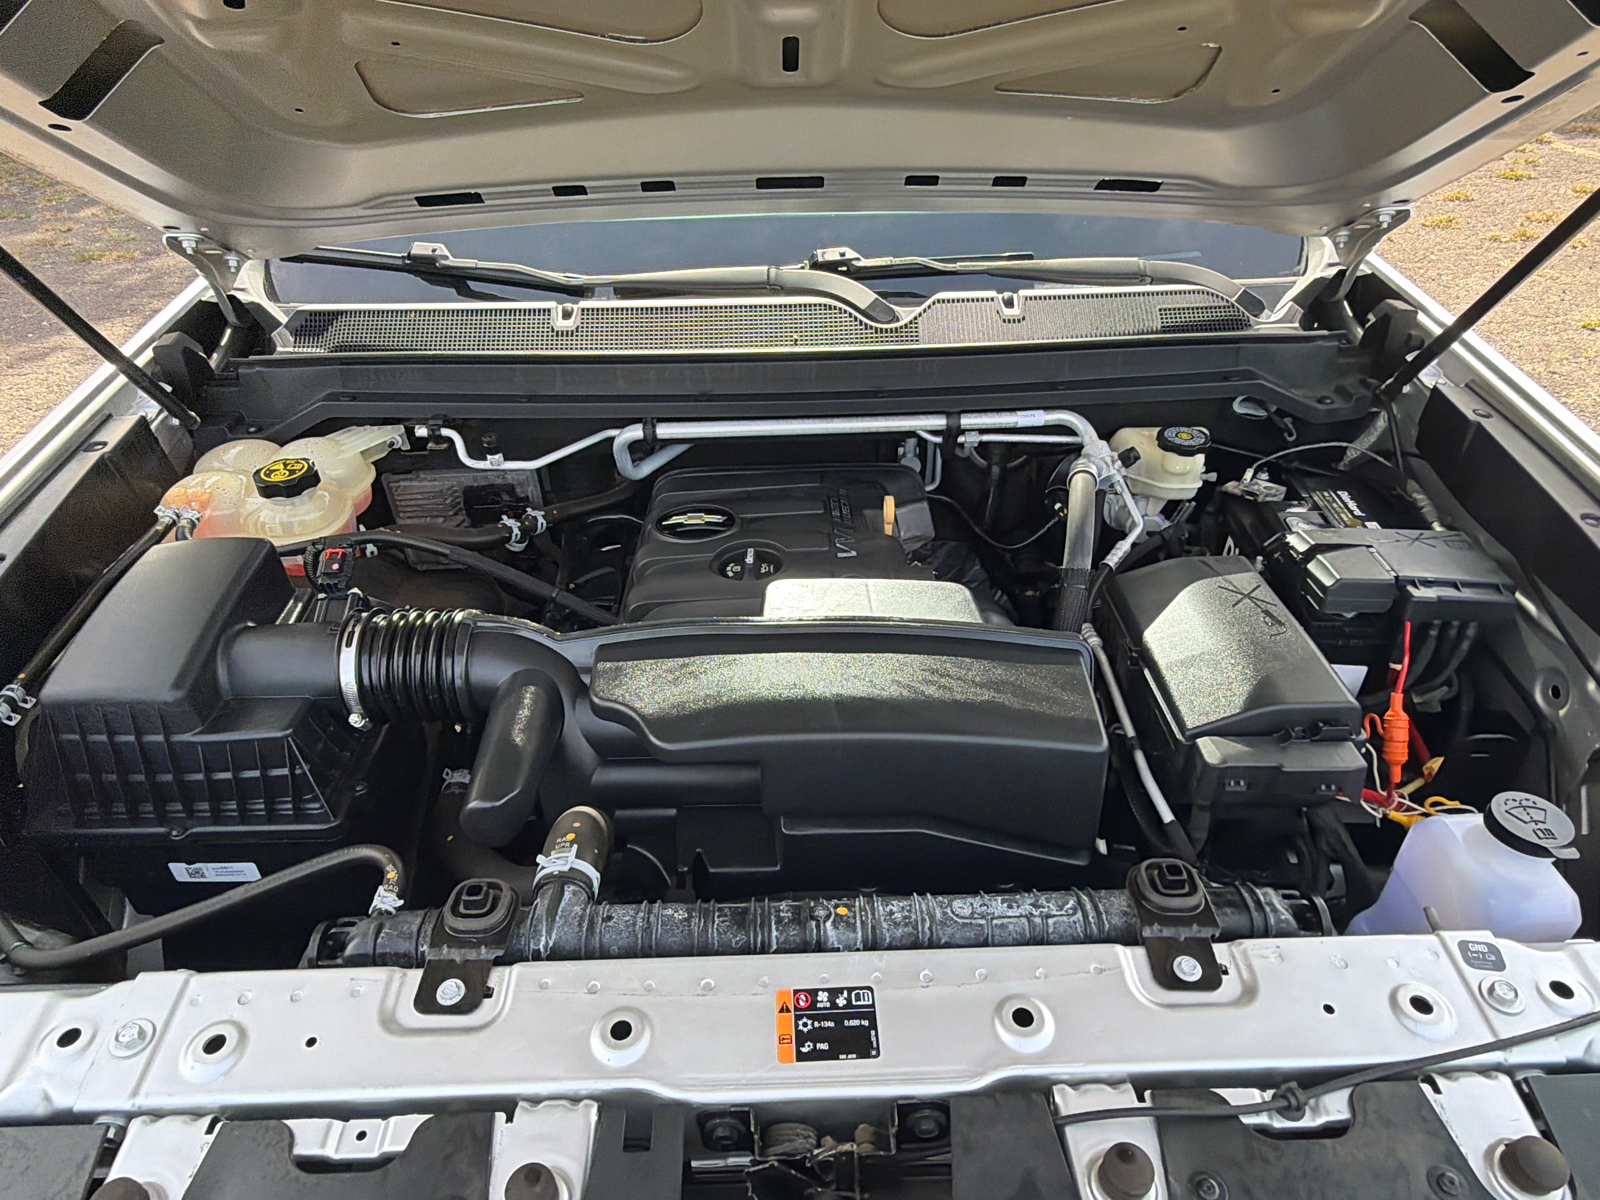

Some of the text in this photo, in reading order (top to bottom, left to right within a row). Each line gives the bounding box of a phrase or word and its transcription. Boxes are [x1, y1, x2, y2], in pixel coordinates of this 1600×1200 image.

[1336, 490, 1366, 516] DieHard
[383, 884, 399, 893] RAD
[1468, 942, 1489, 953] GND
[813, 1020, 835, 1028] R-134a
[816, 1042, 829, 1051] PAG
